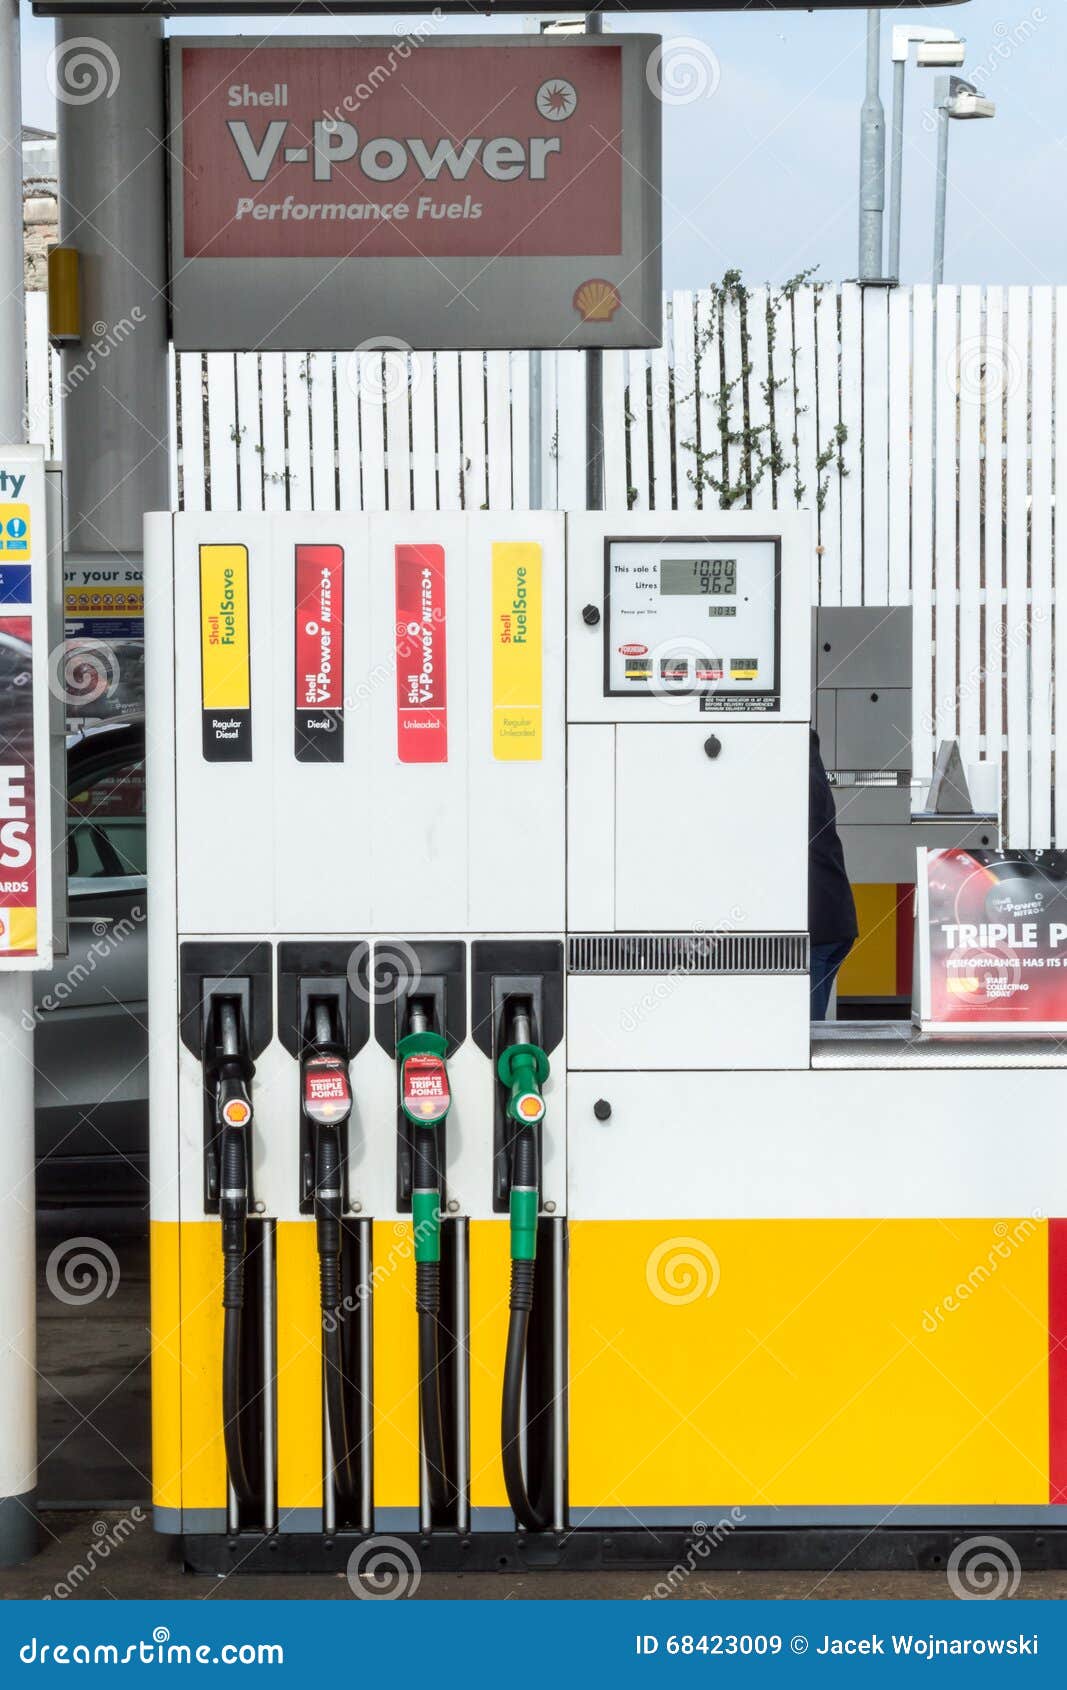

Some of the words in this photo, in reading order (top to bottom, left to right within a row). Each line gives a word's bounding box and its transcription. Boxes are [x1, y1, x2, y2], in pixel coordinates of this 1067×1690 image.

[228, 84, 288, 107] Shell
[226, 119, 562, 182] V-Power
[235, 196, 410, 221] Performance
[416, 195, 483, 220] Fuels
[83, 571, 119, 584] your
[614, 565, 629, 573] This
[693, 560, 735, 577] 10.00
[320, 568, 331, 623] NITRO+
[421, 568, 432, 623] NITRO+
[700, 577, 734, 594] 9.62
[221, 568, 235, 645] FuelSave
[512, 567, 527, 644] FuelSave
[209, 616, 220, 645] Shell
[501, 615, 511, 644] Shell
[317, 628, 331, 703] V-Power
[419, 629, 433, 703] V-Power
[306, 674, 317, 703] Shell
[408, 674, 419, 704] Shell
[212, 719, 241, 730] Regular
[307, 719, 331, 729] Diesel
[404, 720, 440, 729] Unleaded
[216, 730, 239, 739] Diesel
[941, 923, 1038, 949] TRIPLE
[946, 958, 1021, 968] PERFORMANCE
[1023, 958, 1044, 967] HAS
[1047, 958, 1062, 967] ITS
[986, 990, 1012, 998] TODAY
[310, 1082, 343, 1091] TRIPLE
[311, 1090, 344, 1098] POINTS
[410, 1080, 442, 1089] TRIPLE
[410, 1088, 443, 1096] POINTS
